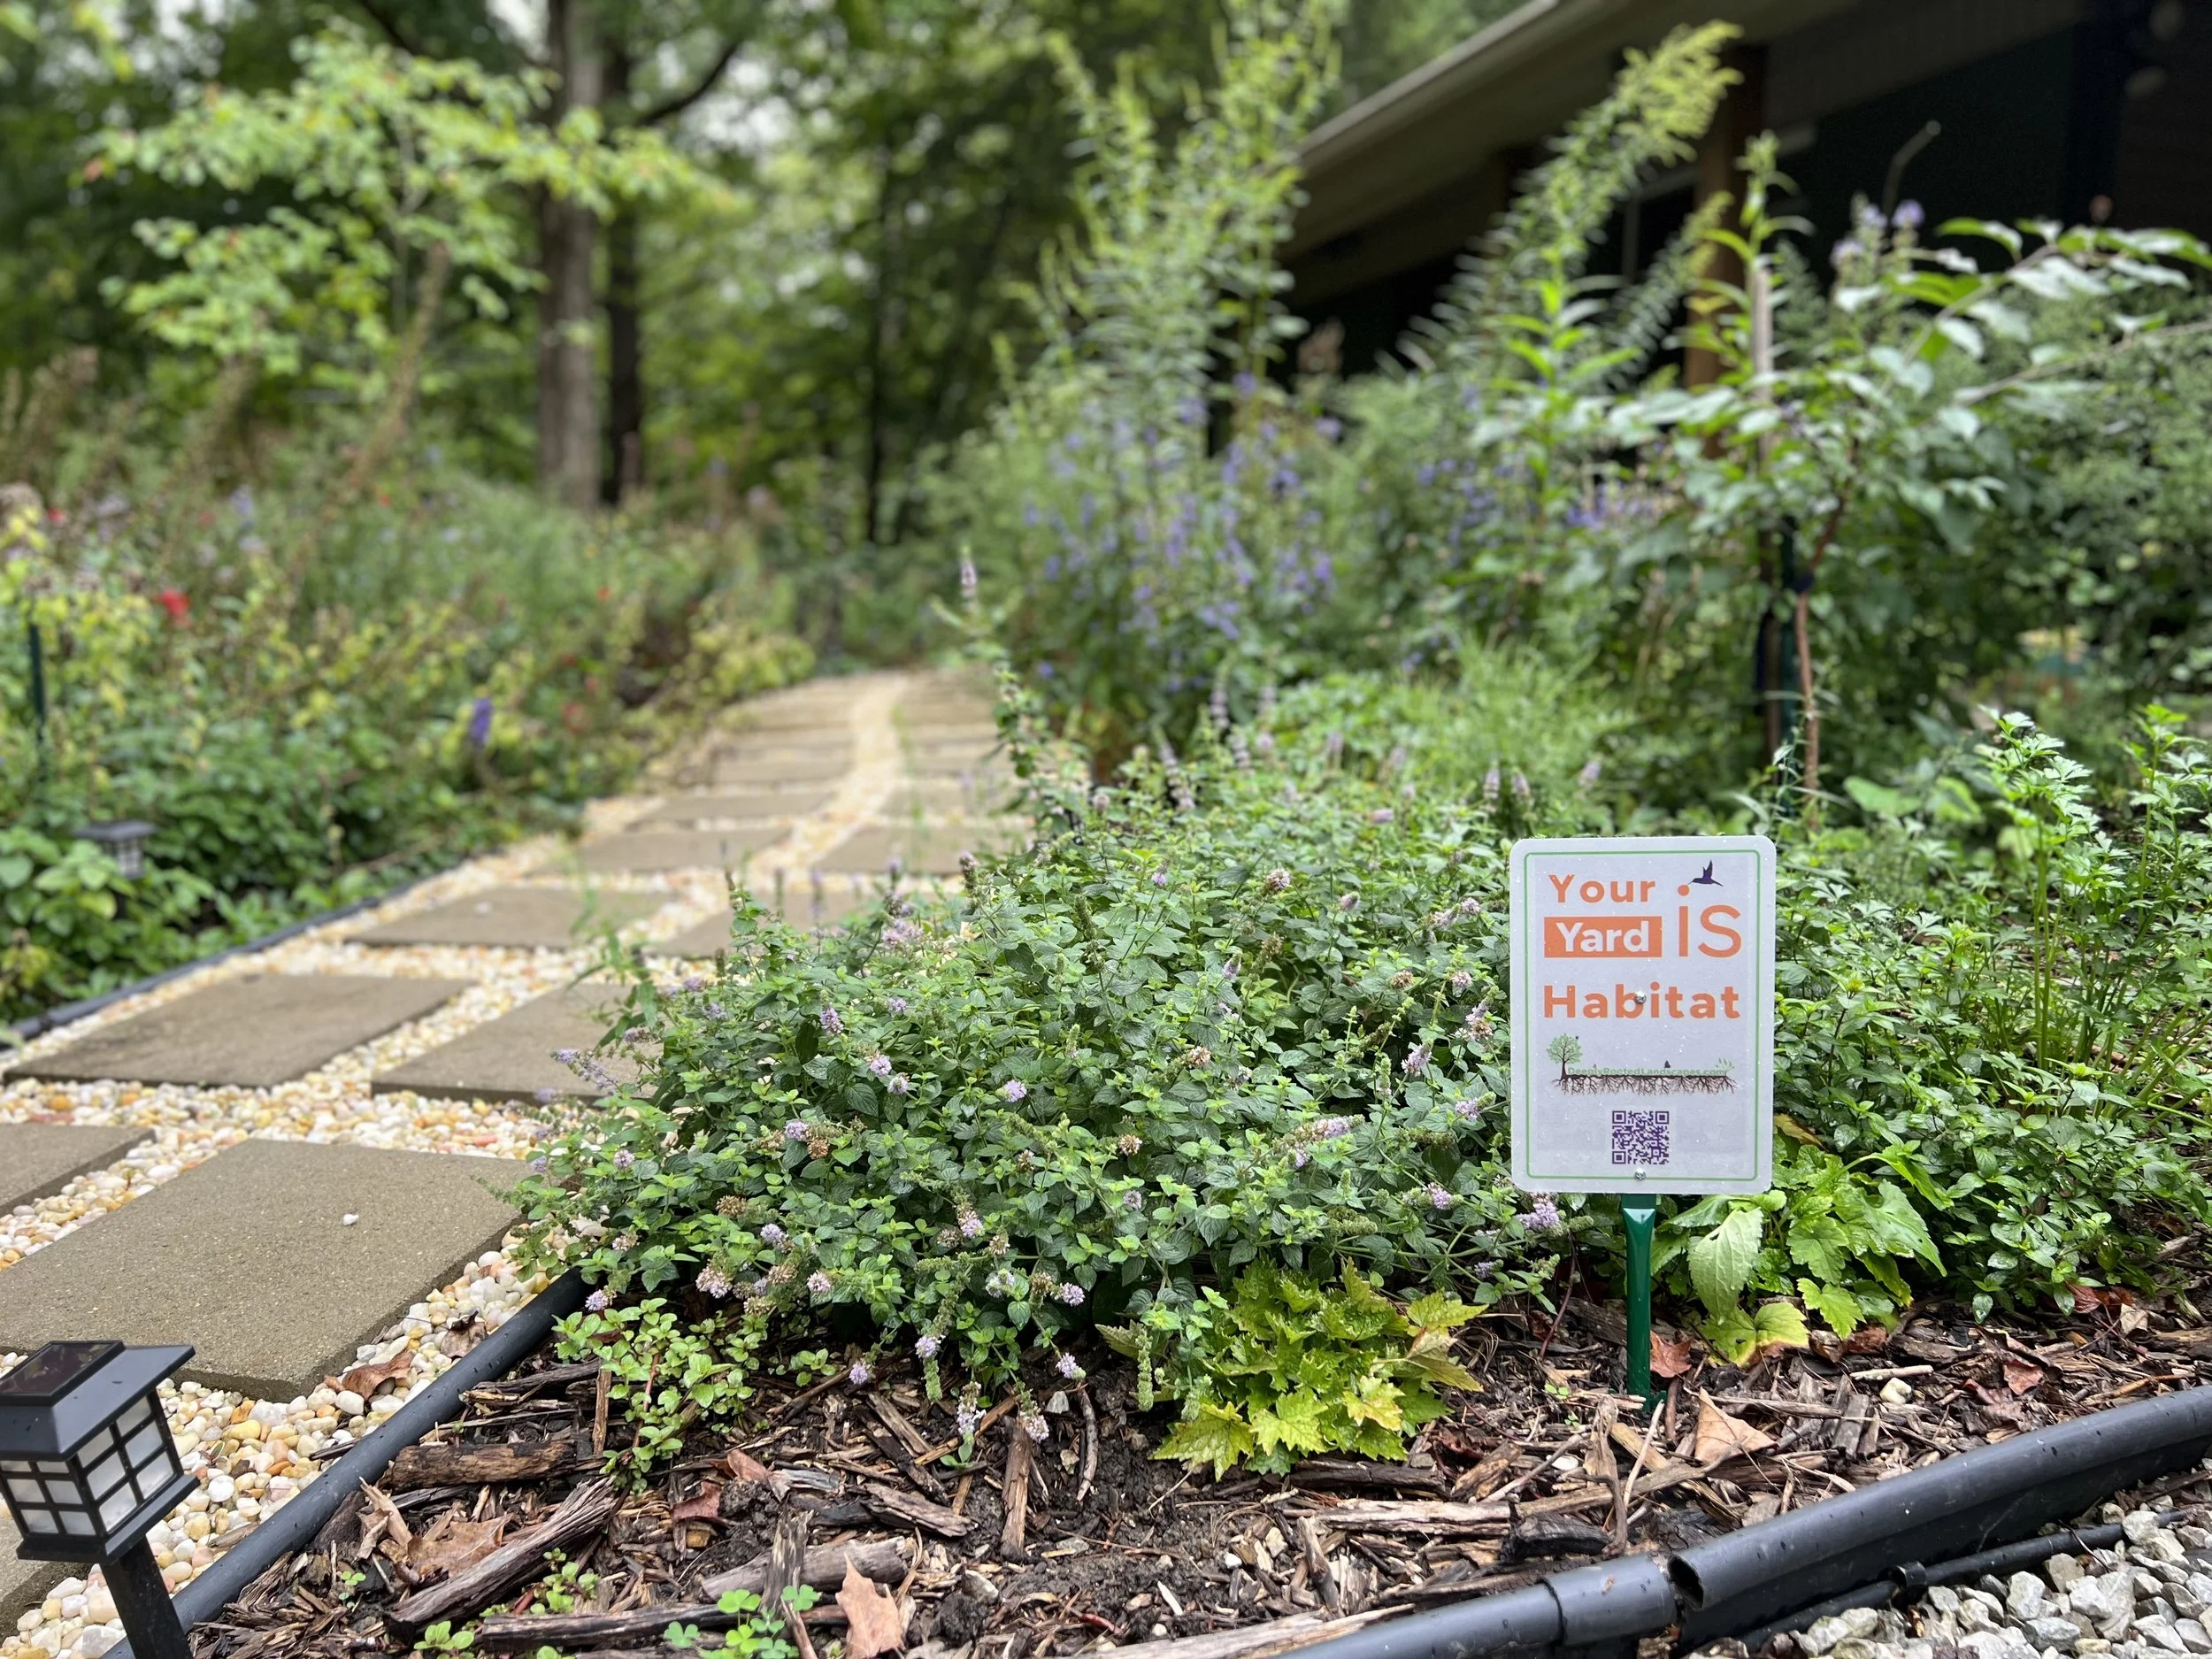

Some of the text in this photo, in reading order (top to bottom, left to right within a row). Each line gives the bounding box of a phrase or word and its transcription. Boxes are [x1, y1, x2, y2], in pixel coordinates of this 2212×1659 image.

[1549, 874, 1655, 902] Your
[1556, 921, 1649, 952] Yard
[1544, 981, 1740, 1018] Habitat
[1568, 1066, 1726, 1077] DeeplyRootedLandscapes.com
